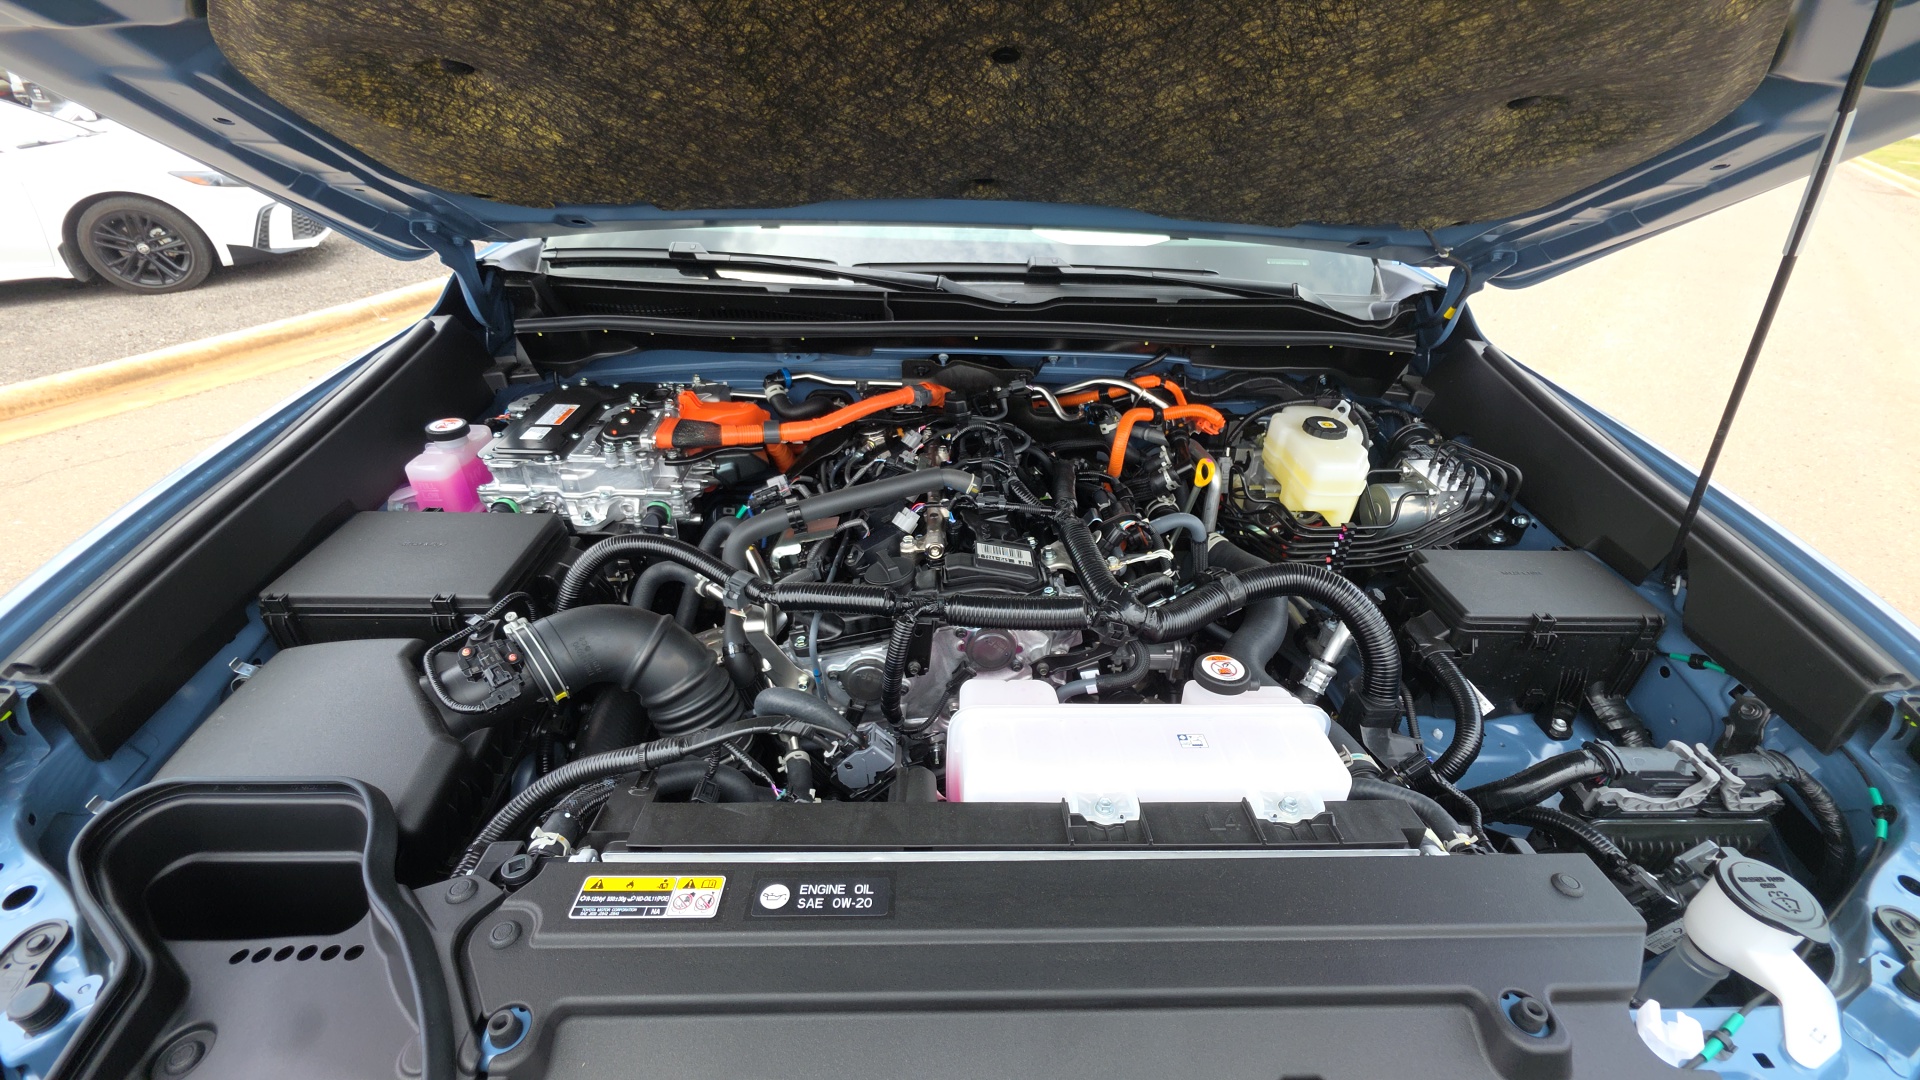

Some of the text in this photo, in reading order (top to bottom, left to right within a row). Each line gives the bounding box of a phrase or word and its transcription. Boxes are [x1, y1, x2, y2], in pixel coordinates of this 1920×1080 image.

[799, 884, 874, 895] ENGINE OIL
[797, 897, 873, 909] SAE 0W-20
